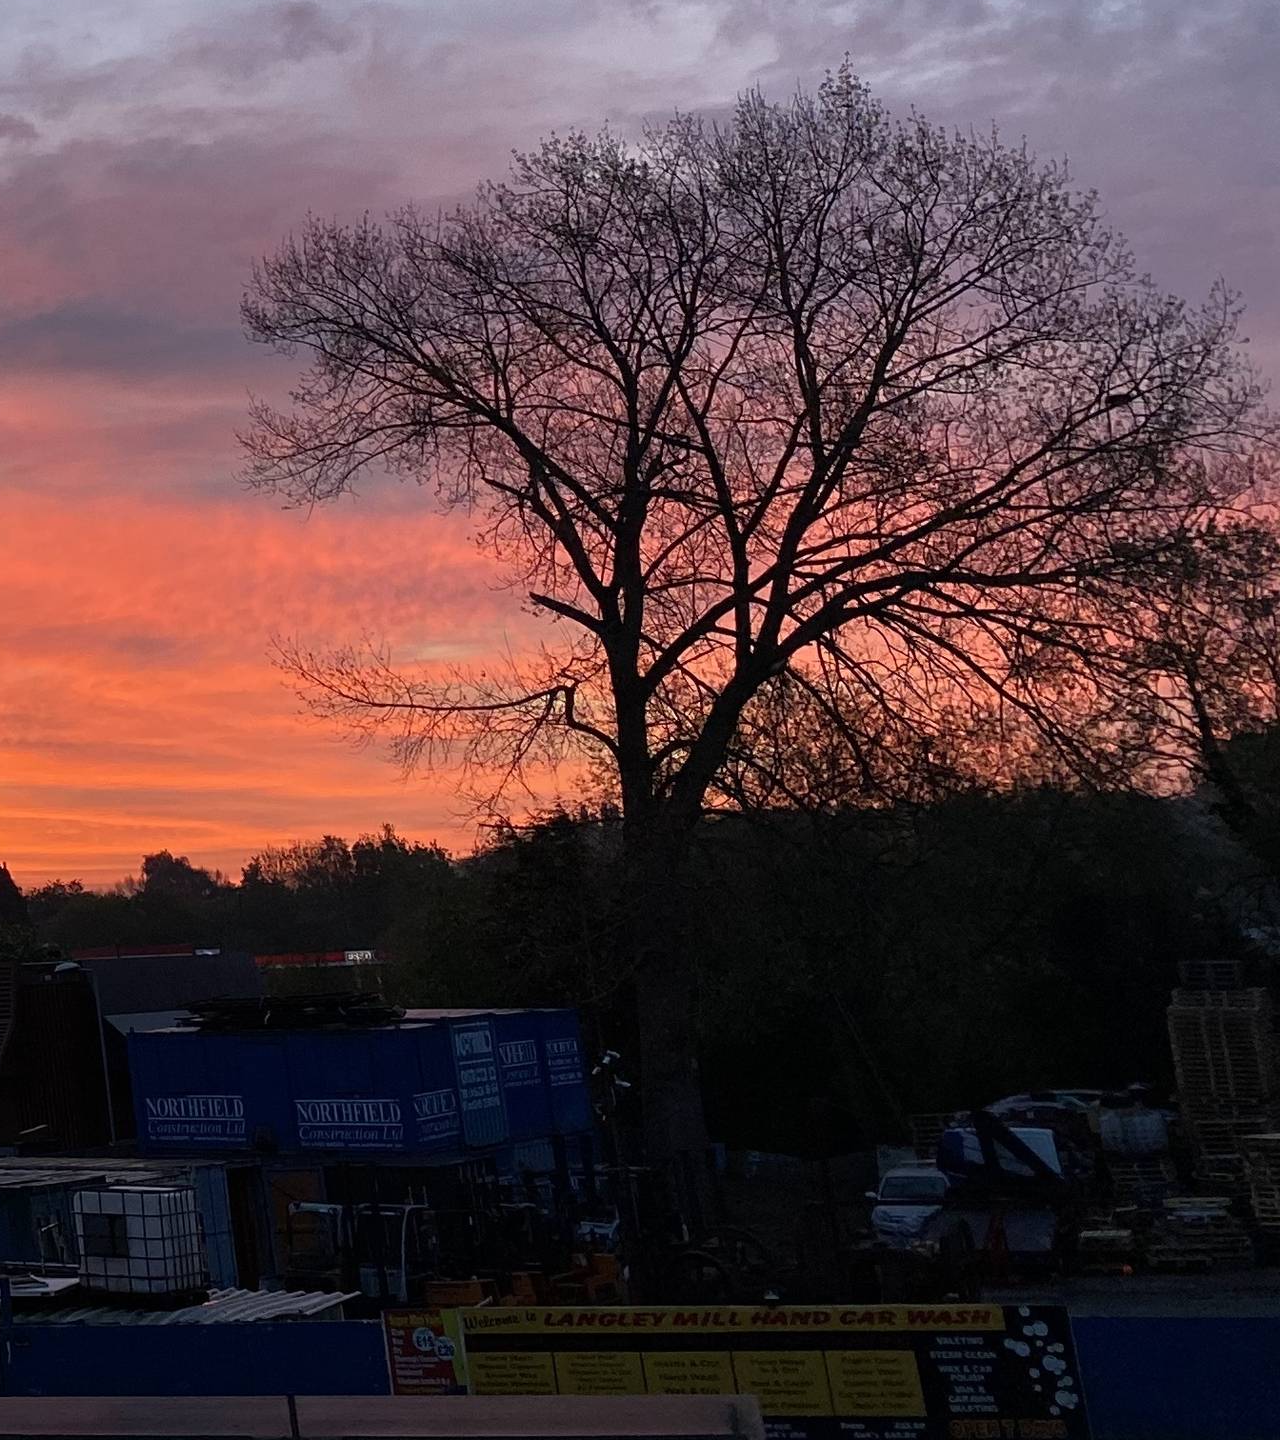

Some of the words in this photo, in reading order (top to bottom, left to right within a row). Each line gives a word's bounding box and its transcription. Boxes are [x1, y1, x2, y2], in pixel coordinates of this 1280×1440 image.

[144, 1097, 244, 1118] NORTHFIELD
[295, 1101, 401, 1122] NORTHFIELD
[147, 1119, 222, 1135] Construction
[298, 1125, 379, 1141] Construction
[464, 1315, 520, 1330] Welcome
[543, 1312, 667, 1327] LANGLEY
[672, 1311, 743, 1327] MILL
[750, 1311, 832, 1326] HAND
[838, 1311, 896, 1326] CAR
[907, 1310, 992, 1325] WASH
